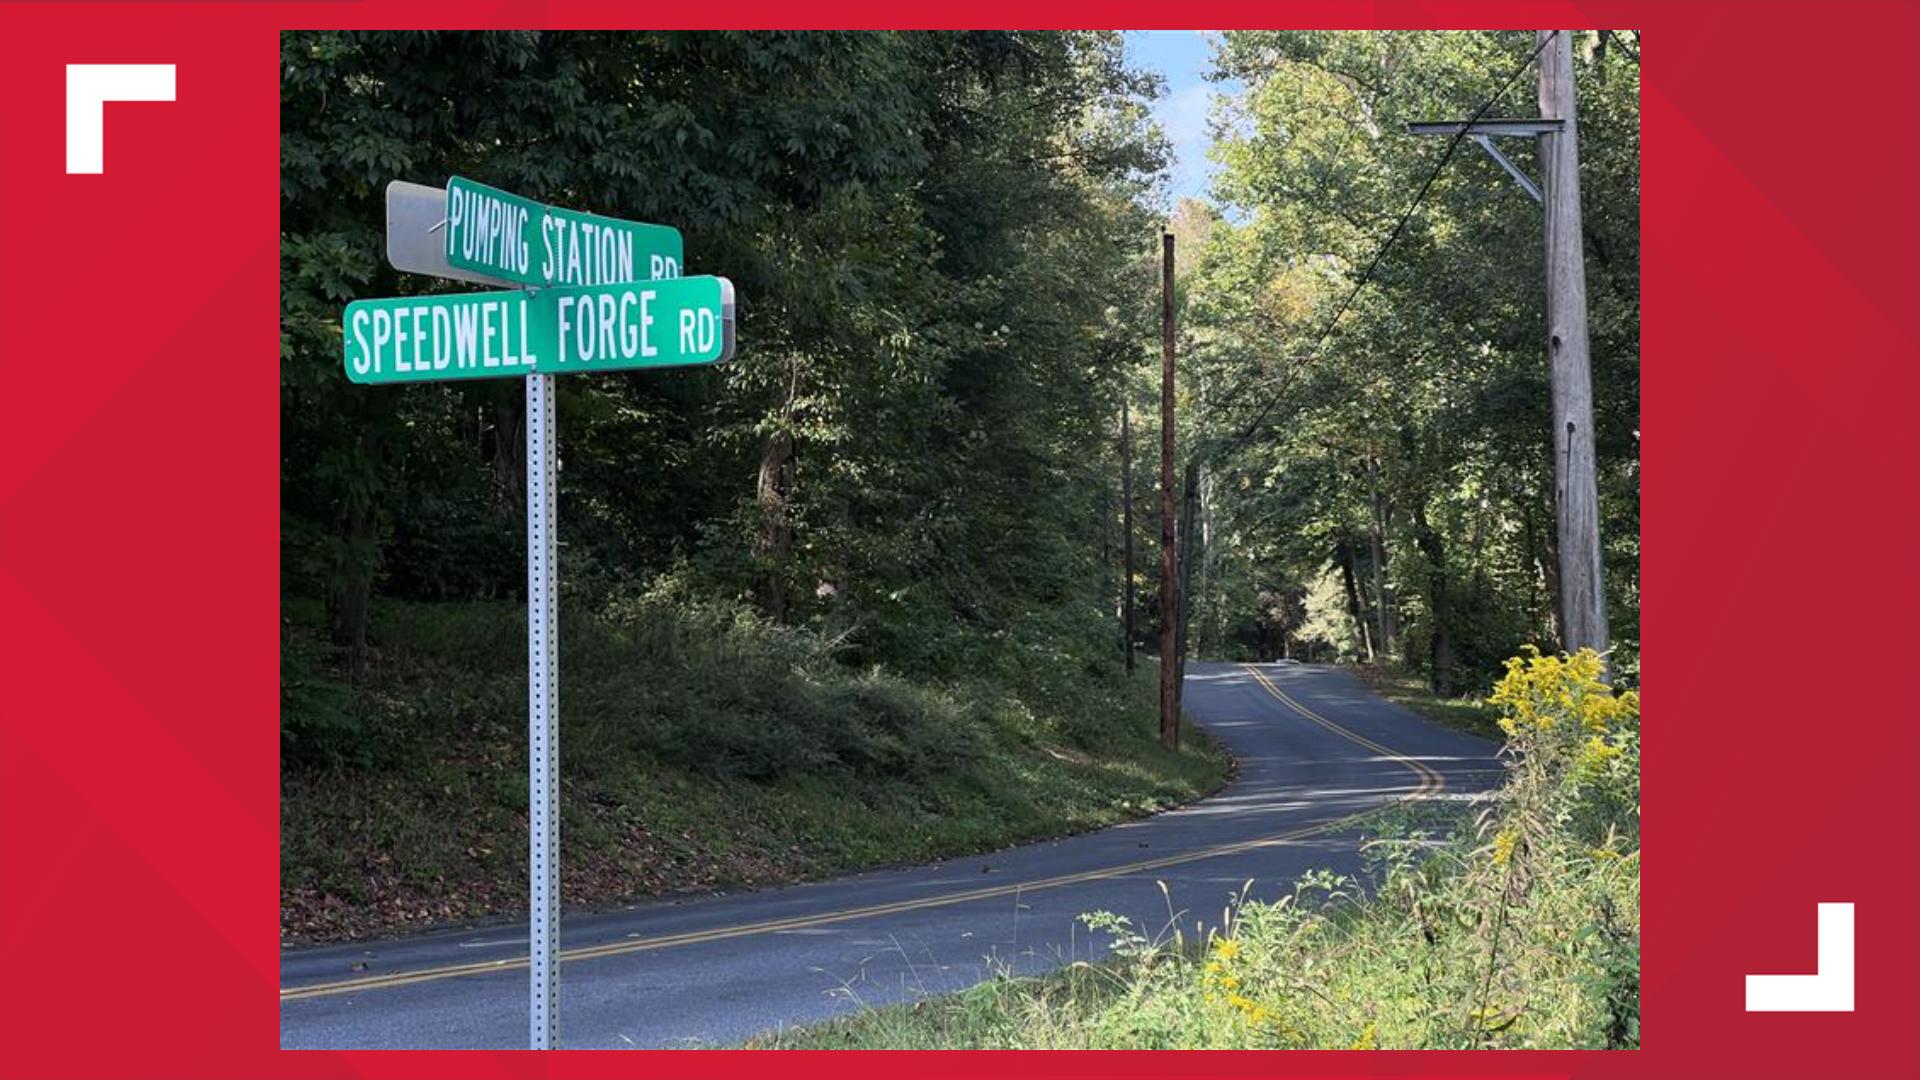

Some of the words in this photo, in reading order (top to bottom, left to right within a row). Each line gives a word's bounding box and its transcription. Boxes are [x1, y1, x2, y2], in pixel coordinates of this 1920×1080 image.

[449, 186, 529, 276] PUMPING
[542, 214, 633, 286] STATION
[650, 254, 678, 281] RD
[352, 301, 537, 375] SPEEDWELL
[558, 290, 658, 362] FORGE
[680, 307, 715, 354] RD
